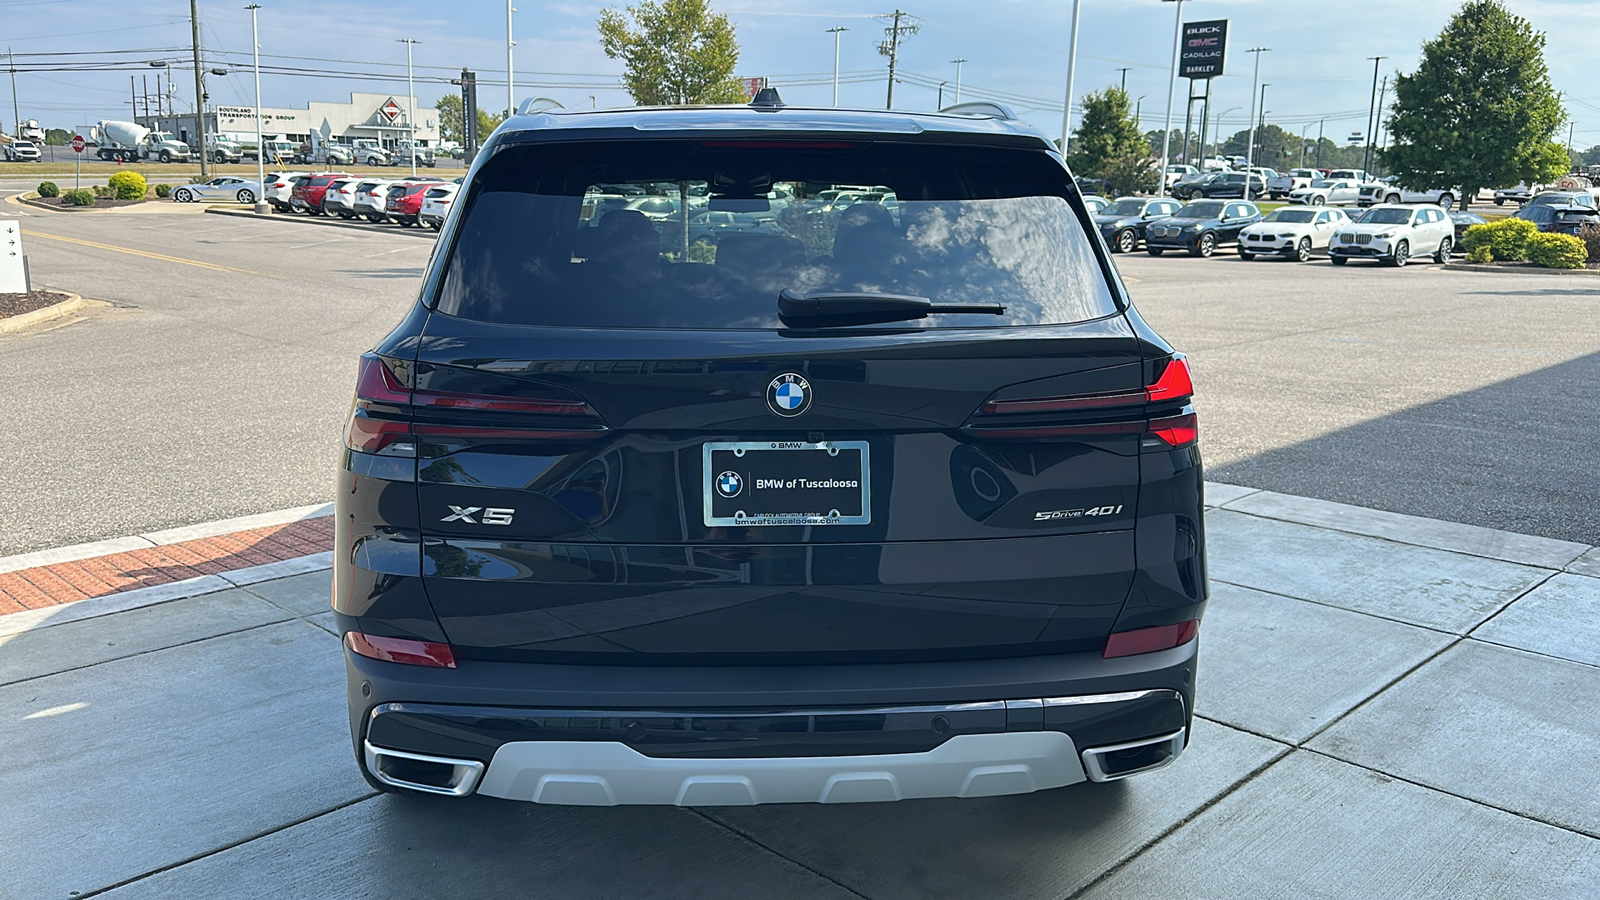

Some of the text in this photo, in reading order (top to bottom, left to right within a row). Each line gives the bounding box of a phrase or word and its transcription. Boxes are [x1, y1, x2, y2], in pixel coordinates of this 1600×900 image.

[1187, 26, 1220, 34] BUICK
[1188, 38, 1218, 47] GMC
[1183, 51, 1221, 59] CADILLAC
[1186, 65, 1214, 73] BARKLEY
[771, 375, 808, 390] BMW
[756, 478, 858, 489] BMW of Tuscaloosa
[440, 504, 516, 526] X5
[735, 517, 840, 525] bmwoftuscaloosa.com
